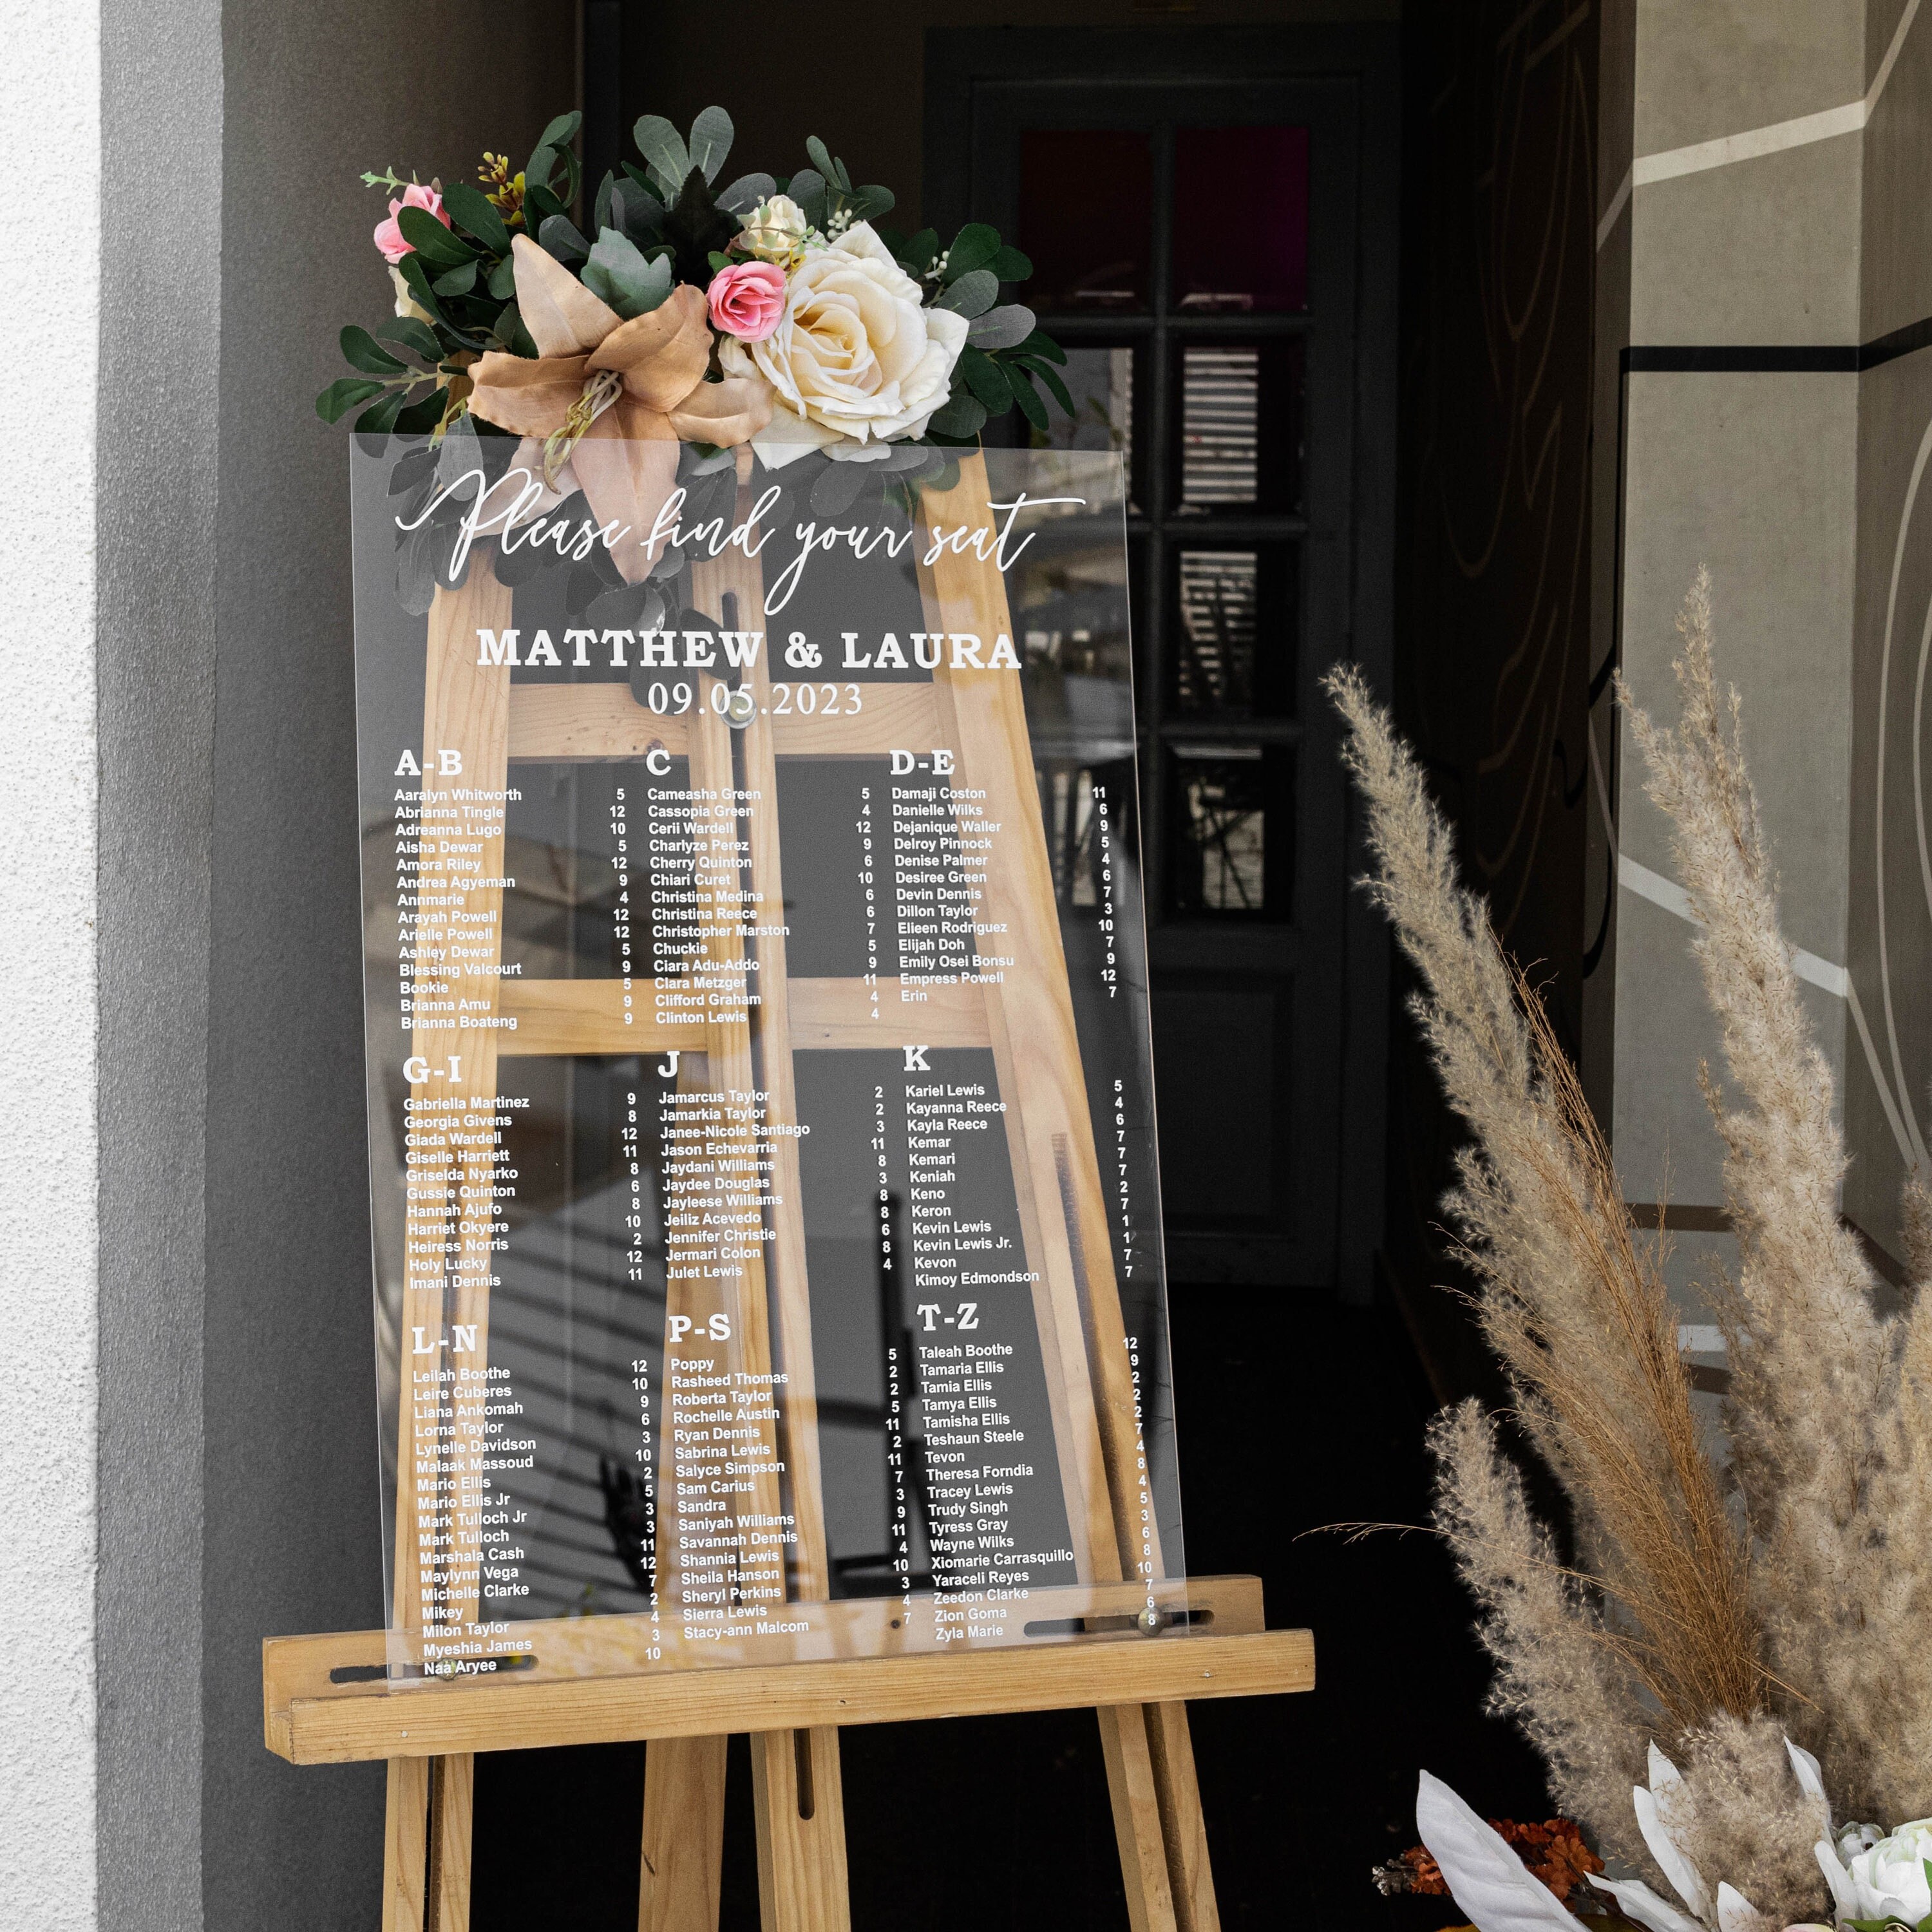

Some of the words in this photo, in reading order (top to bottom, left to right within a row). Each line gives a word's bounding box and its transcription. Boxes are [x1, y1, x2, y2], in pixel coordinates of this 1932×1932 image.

[395, 468, 632, 582] Please
[639, 485, 781, 561] find
[762, 518, 913, 616] your
[923, 492, 1086, 572] seat
[476, 629, 764, 667] MATTHEW
[784, 631, 822, 668] &
[840, 632, 1022, 669] LAURA
[648, 682, 862, 717] 09.05.2023
[394, 749, 462, 776] A-B
[646, 749, 672, 776] C
[889, 749, 955, 775] D-E
[393, 788, 448, 804] Aaralyn
[451, 788, 522, 801] Whitworth
[616, 788, 625, 800] 5
[647, 788, 717, 800] Cameasha
[721, 788, 761, 800] Green
[862, 787, 870, 800] 5
[891, 787, 936, 802] Damaji
[940, 787, 986, 799] Coston
[1092, 786, 1106, 799] 11
[893, 820, 958, 836] Dejanique
[961, 820, 1002, 832] Waller
[395, 841, 435, 853] Aisha
[440, 840, 484, 853] Dewar
[649, 839, 708, 855] Charlyze
[712, 839, 749, 851] Perez
[895, 854, 940, 867] Denise
[942, 854, 989, 866] Palmer
[1101, 852, 1110, 864] 4
[396, 876, 447, 889] Andrea
[450, 875, 516, 891] Agyeman
[619, 874, 628, 887] 9
[650, 873, 690, 886] Chiari
[694, 873, 731, 886] Curet
[858, 871, 873, 884] 10
[897, 905, 935, 917] Dillon
[938, 904, 979, 920] Taylor
[398, 928, 443, 942] Arielle
[447, 927, 493, 940] Powell
[652, 925, 732, 940] Christopher
[735, 924, 790, 936] Marston
[654, 960, 689, 972] Ciara
[692, 958, 760, 972] Adu-Addo
[868, 956, 877, 969] 9
[899, 955, 936, 971] Emily
[939, 954, 969, 967] Osei
[972, 954, 1014, 967] Bonsu
[1106, 952, 1115, 965] 9
[399, 963, 460, 978] Blessing
[464, 962, 522, 975] Valcourt
[622, 960, 631, 973] 9
[901, 990, 927, 1002] Erin
[401, 1016, 455, 1030] Brianna
[460, 1016, 518, 1030] Boateng
[656, 1011, 705, 1024] Clinton
[708, 1010, 748, 1023] Lewis
[658, 1050, 680, 1078] J
[902, 1045, 931, 1072] K
[402, 1056, 462, 1084] G-I
[875, 1086, 883, 1098] 2
[905, 1084, 943, 1097] Kariel
[947, 1083, 985, 1096] Lewis
[1114, 1079, 1122, 1092] 5
[403, 1097, 466, 1111] Gabriella
[470, 1095, 530, 1109] Martinez
[627, 1092, 636, 1105] 9
[658, 1092, 725, 1104] Jamarcus
[728, 1089, 770, 1104] Taylor
[659, 1124, 748, 1139] Janee-Nicole
[751, 1123, 810, 1138] Santiago
[907, 1119, 944, 1134] Kayla
[947, 1118, 988, 1130] Reece
[404, 1133, 446, 1146] Giada
[449, 1131, 502, 1145] Wardell
[878, 1154, 887, 1167] 8
[909, 1152, 956, 1166] Kemari
[1117, 1147, 1126, 1159] 7
[661, 1160, 714, 1177] Jaydani
[717, 1159, 775, 1172] Williams
[406, 1186, 456, 1200] Gussie
[459, 1185, 516, 1198] Quinton
[631, 1180, 639, 1193] 6
[662, 1178, 711, 1194] Jaydee
[714, 1176, 770, 1191] Douglas
[911, 1188, 945, 1200] Keno
[911, 1205, 951, 1217] Keron
[1121, 1197, 1129, 1210] 7
[408, 1222, 456, 1236] Harriet
[459, 1221, 509, 1236] Okyere
[665, 1230, 721, 1244] Jennifer
[724, 1228, 776, 1242] Christie
[882, 1224, 890, 1236] 6
[408, 1240, 462, 1254] Heiress
[466, 1238, 509, 1251] Norris
[633, 1233, 642, 1245] 2
[913, 1238, 951, 1252] Kevin
[954, 1237, 992, 1250] Lewis
[996, 1236, 1012, 1249] Jr.
[666, 1266, 701, 1279] Julet
[703, 1264, 743, 1278] Lewis
[915, 1274, 958, 1288] Kimoy
[961, 1270, 1039, 1285] Edmondson
[1124, 1265, 1133, 1278] 7
[410, 1275, 448, 1289] Imani
[452, 1274, 501, 1288] Dennis
[916, 1302, 979, 1331] T-Z
[668, 1313, 731, 1343] P-S
[412, 1324, 478, 1354] L-N
[1122, 1336, 1138, 1349] 12
[888, 1348, 897, 1361] 5
[918, 1345, 962, 1359] Taleah
[965, 1343, 1013, 1357] Boothe
[631, 1359, 648, 1372] 12
[670, 1358, 714, 1372] Poppy
[413, 1368, 456, 1383] Leilah
[460, 1366, 511, 1381] Boothe
[922, 1399, 965, 1413] Tamya
[969, 1396, 997, 1409] Ellis
[673, 1409, 733, 1424] Rochelle
[735, 1406, 780, 1421] Austin
[415, 1425, 456, 1437] Lorna
[460, 1421, 504, 1437] Taylor
[1136, 1439, 1144, 1452] 4
[887, 1453, 901, 1466] 11
[924, 1451, 965, 1464] Tevon
[643, 1466, 652, 1479] 2
[676, 1464, 721, 1479] Salyce
[725, 1462, 785, 1476] Simpson
[417, 1477, 457, 1492] Mario
[461, 1475, 491, 1490] Ellis
[927, 1486, 972, 1500] Tracey
[974, 1482, 1014, 1496] Lewis
[677, 1499, 726, 1513] Sandra
[419, 1532, 454, 1547] Mark
[457, 1529, 509, 1544] Tulloch
[1142, 1526, 1150, 1539] 6
[899, 1541, 908, 1553] 4
[930, 1539, 975, 1553] Wayne
[978, 1535, 1014, 1549] Wilks
[680, 1552, 736, 1567] Shannia
[740, 1549, 780, 1564] Lewis
[649, 1574, 658, 1587] 7
[421, 1586, 480, 1602] Michelle
[484, 1583, 529, 1598] Clarke
[933, 1591, 983, 1605] Zeedon
[987, 1587, 1029, 1601] Clarke
[683, 1608, 724, 1622] Sierra
[728, 1604, 768, 1618] Lewis
[423, 1641, 482, 1659] Myeshia
[486, 1640, 533, 1653] James
